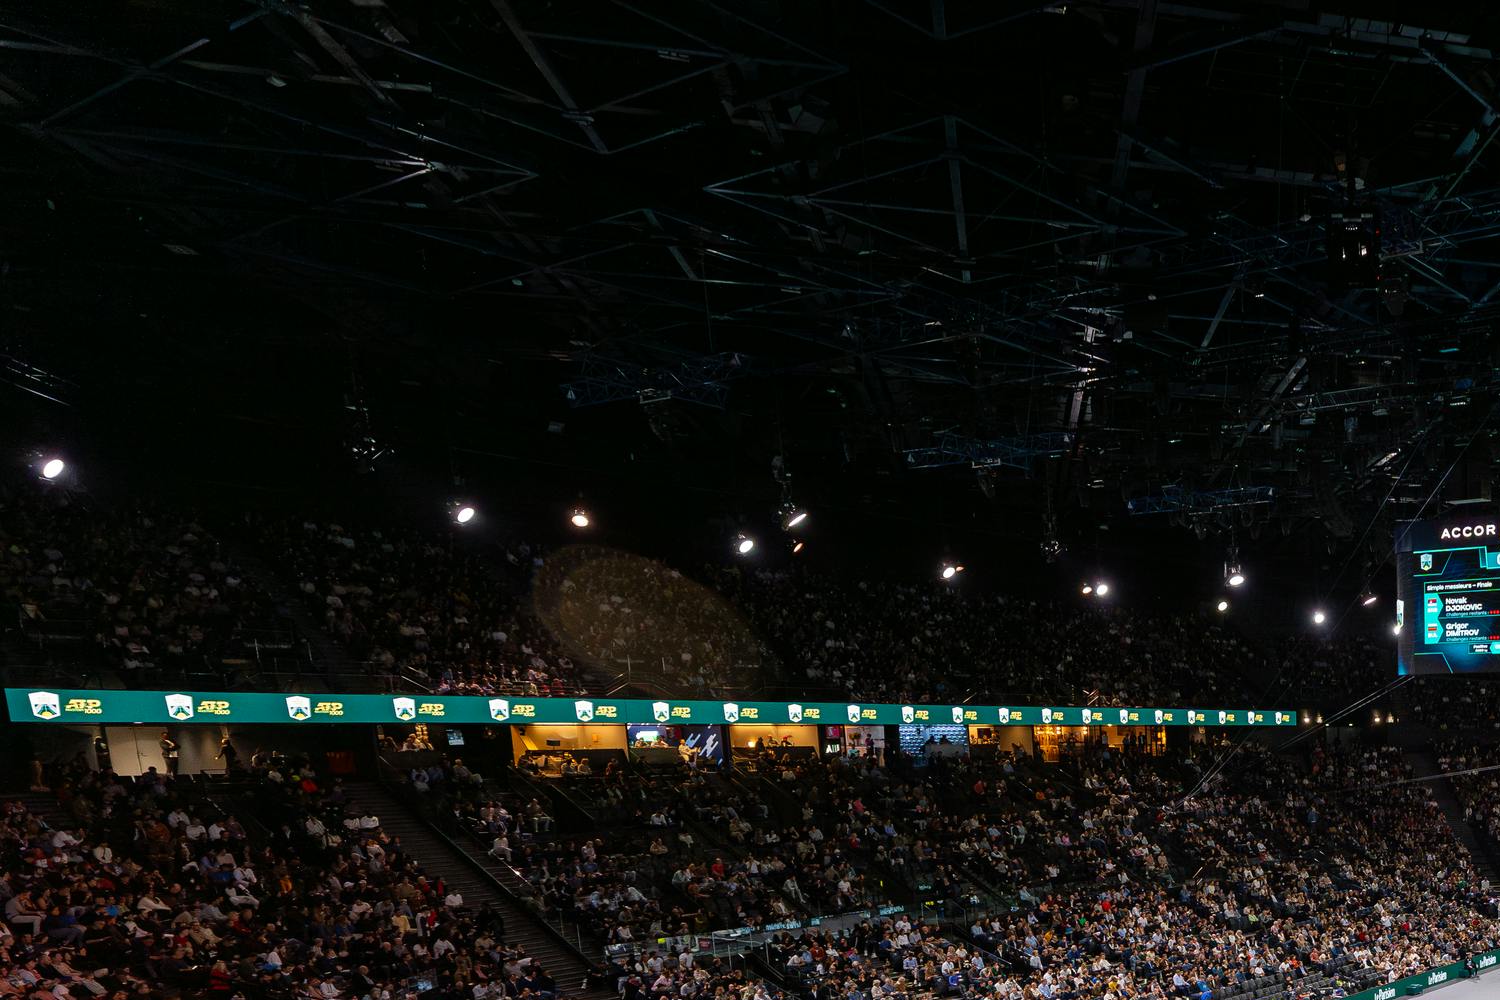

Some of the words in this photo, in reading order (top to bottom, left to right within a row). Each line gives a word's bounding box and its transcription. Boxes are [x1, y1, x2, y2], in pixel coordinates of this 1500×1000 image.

[1441, 523, 1496, 540] ACCOR
[1445, 597, 1467, 605] Novak
[1445, 603, 1483, 612] DJOKOVIC
[1445, 622, 1469, 630] Grigor
[1445, 629, 1480, 637] DIMITROV
[65, 699, 101, 711] ATP
[198, 700, 230, 711] ATP
[315, 702, 343, 712] ATP
[419, 703, 444, 713] ATP
[512, 705, 535, 714] ATP
[1432, 970, 1447, 984] Parisien
[1379, 987, 1396, 1000] Parisien
